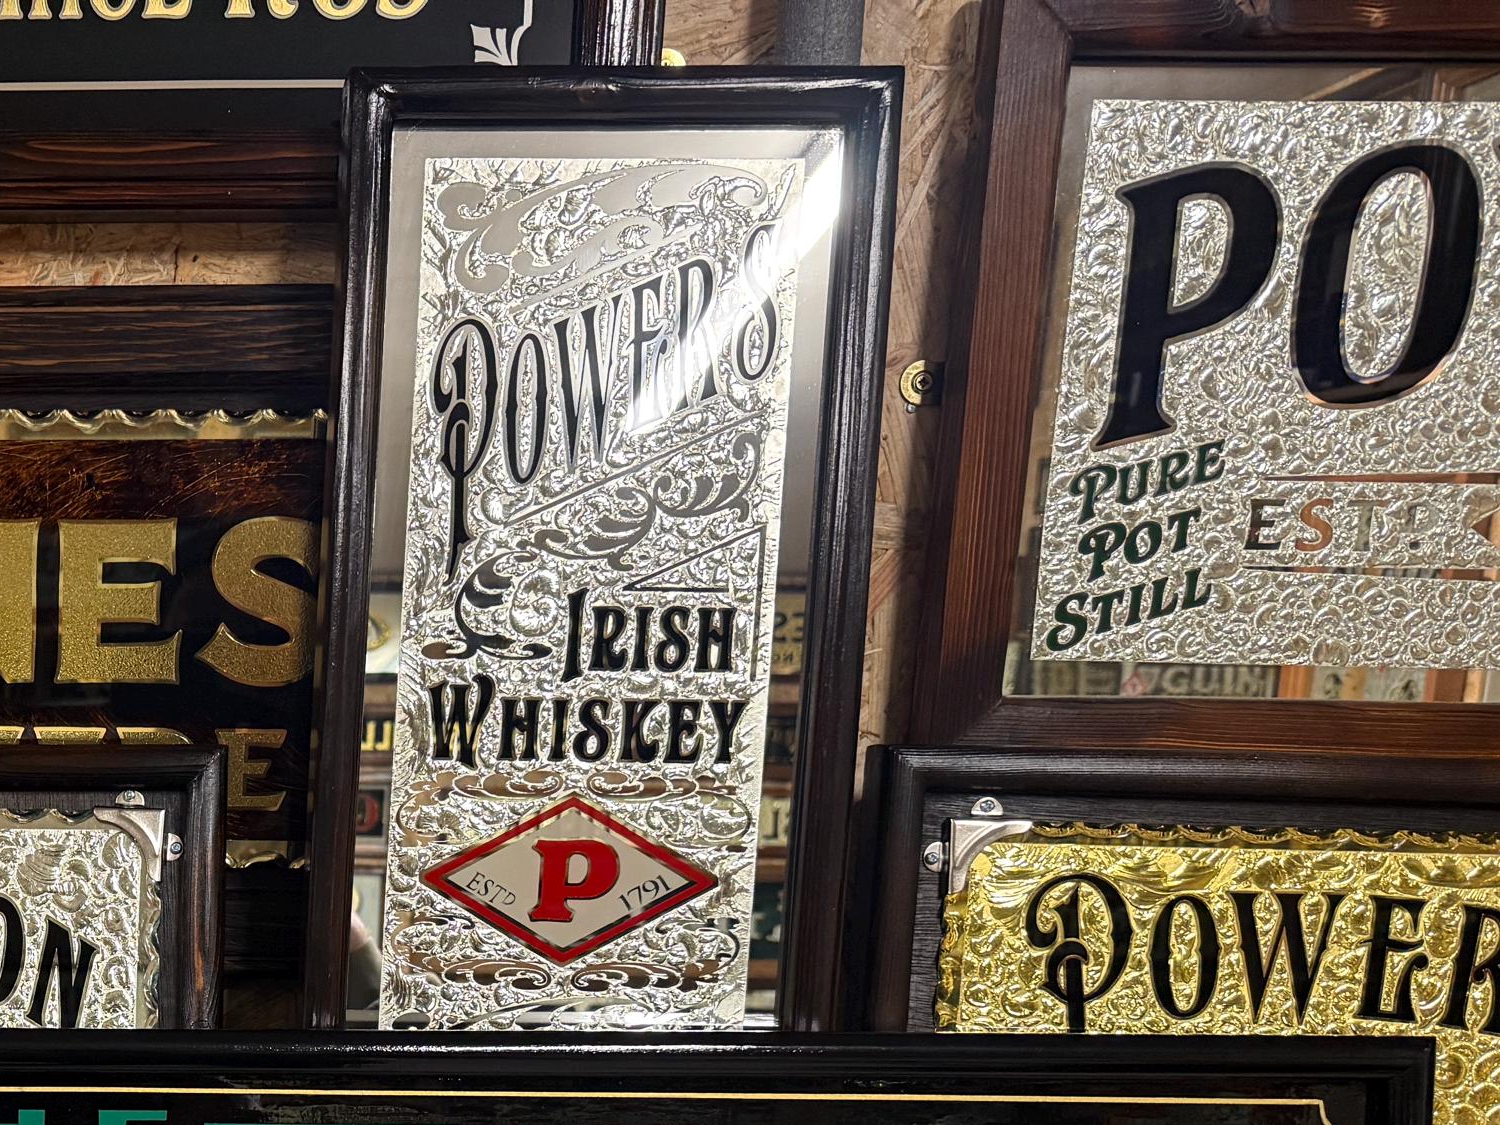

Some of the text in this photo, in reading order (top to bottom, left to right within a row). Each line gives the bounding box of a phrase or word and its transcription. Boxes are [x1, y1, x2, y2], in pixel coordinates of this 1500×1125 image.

[1092, 138, 1500, 450] PO
[433, 222, 780, 577] POWERS
[1070, 440, 1226, 524] PURE
[1078, 508, 1202, 582] POT
[563, 586, 738, 682] IRISH
[1046, 568, 1213, 651] STILL
[429, 674, 749, 769] WHISKEY
[528, 838, 621, 922] P
[618, 873, 672, 913] 1791
